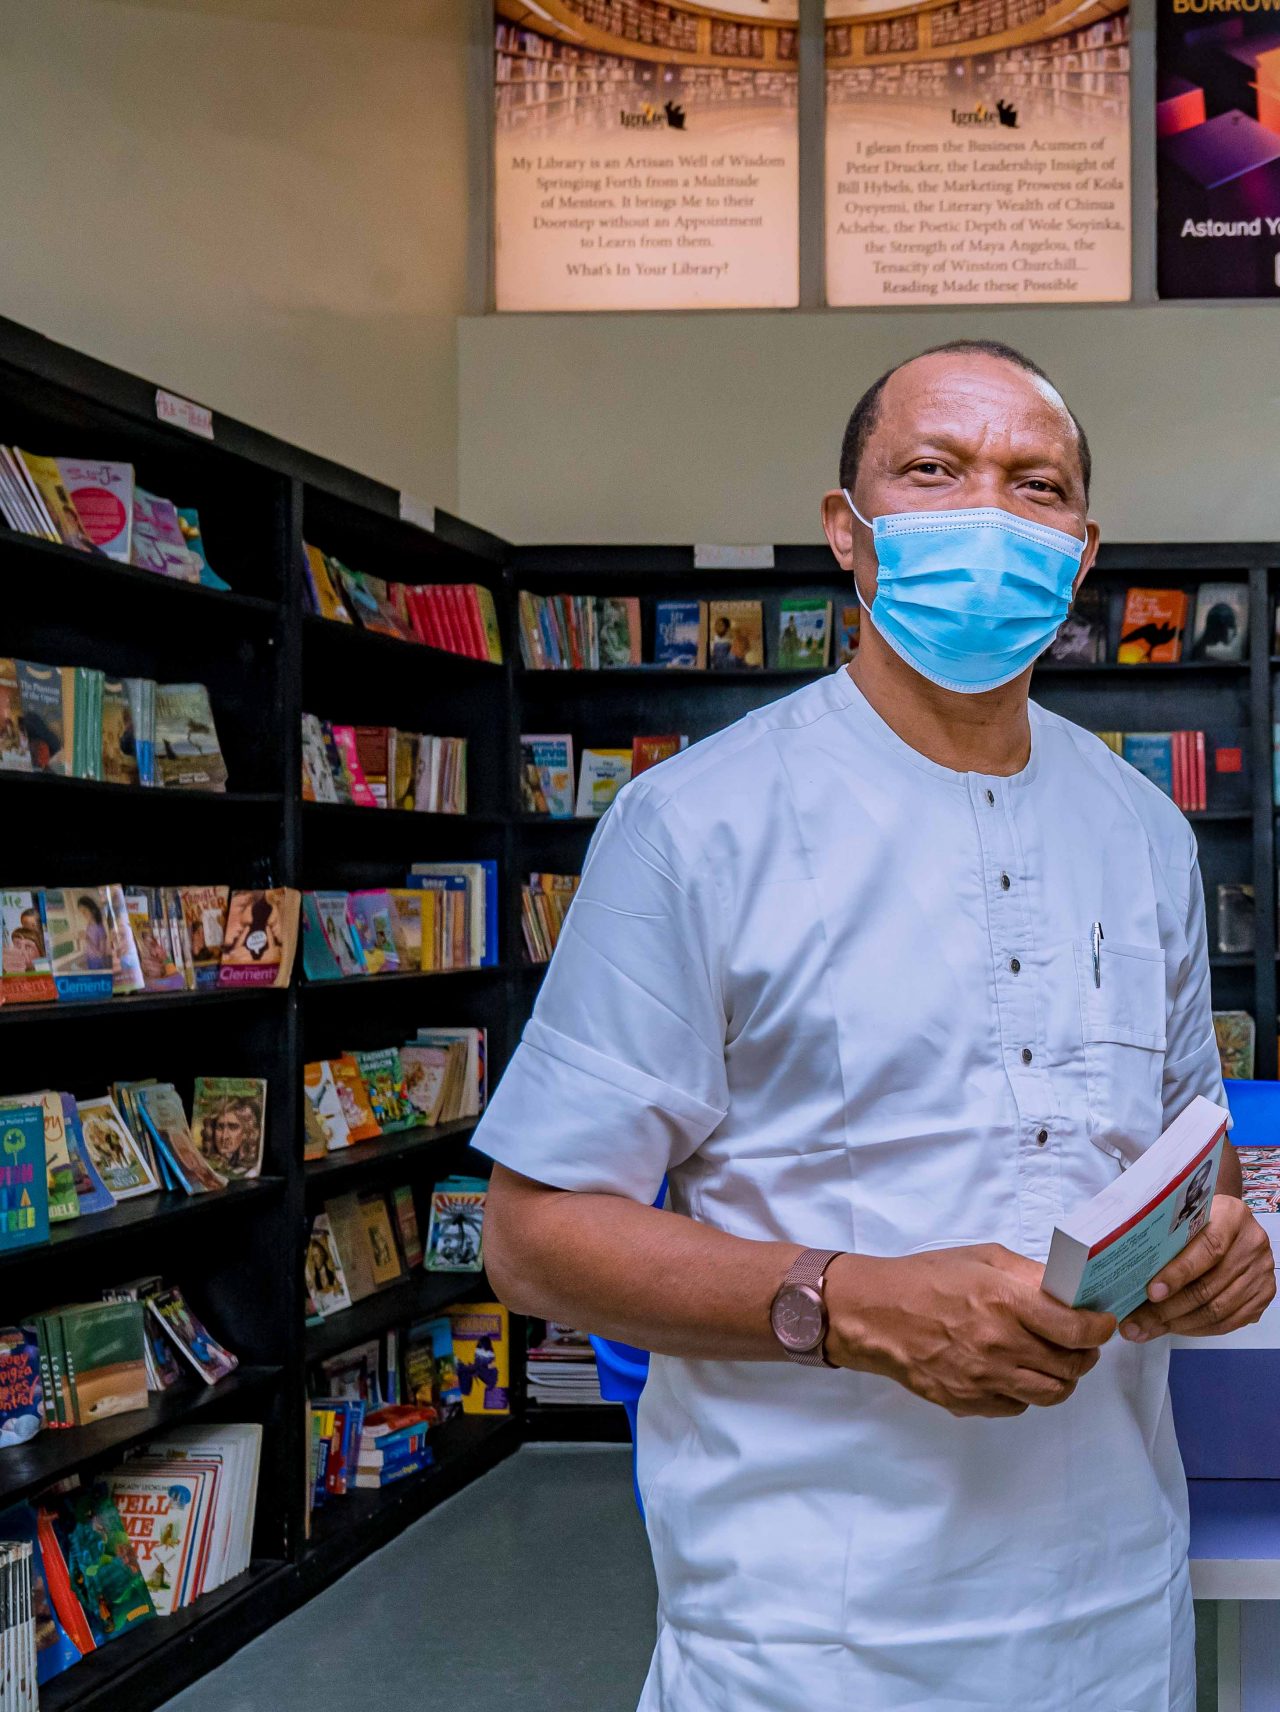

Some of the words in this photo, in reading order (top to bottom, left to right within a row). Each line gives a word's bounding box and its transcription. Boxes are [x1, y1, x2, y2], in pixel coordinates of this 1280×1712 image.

[865, 142, 901, 157] glean
[905, 140, 938, 153] from
[968, 139, 1024, 152] Business
[1030, 139, 1086, 151] Acumen
[511, 157, 532, 171] My
[537, 156, 585, 170] Library
[625, 156, 674, 169] Artisan
[678, 155, 707, 168] Well
[729, 153, 785, 167] Wisdom
[846, 161, 879, 174] Peter
[884, 160, 943, 174] Drucker,
[973, 159, 1046, 175] Leadership
[1051, 158, 1096, 172] Insight
[537, 177, 601, 192] Springing
[606, 176, 642, 188] Forth
[646, 176, 678, 187] from
[694, 174, 758, 187] Multitude
[837, 181, 859, 194] Bill
[864, 180, 913, 195] Hybels,
[943, 180, 1013, 194] Marketing
[1018, 180, 1071, 191] Prowess
[1093, 177, 1123, 190] Kola
[559, 197, 615, 209] Mentors.
[636, 197, 676, 210] brings
[724, 195, 754, 207] their
[939, 200, 992, 215] Literary
[997, 199, 1043, 211] Wealth
[533, 217, 594, 231] Doorstep
[600, 216, 649, 229] without
[675, 215, 762, 231] Appointment
[919, 220, 960, 233] Poetic
[965, 219, 1006, 234] Depth
[1029, 218, 1062, 231] Wole
[1180, 218, 1260, 238] Astound
[598, 236, 636, 248] Learn
[641, 235, 672, 247] from
[677, 235, 714, 247] them.
[890, 240, 947, 256] Strength
[969, 240, 1005, 255] Maya
[1010, 239, 1070, 254] Angelou,
[566, 263, 612, 276] What's
[636, 262, 667, 275] Your
[672, 262, 729, 279] Library?
[873, 260, 928, 276] Tenacity
[951, 259, 1007, 272] Winston
[883, 280, 938, 295] Reading
[943, 280, 980, 292] Made
[984, 279, 1019, 292] these
[1024, 279, 1078, 291] Possible
[58, 978, 111, 994] Clements
[115, 1494, 169, 1516] TELL
